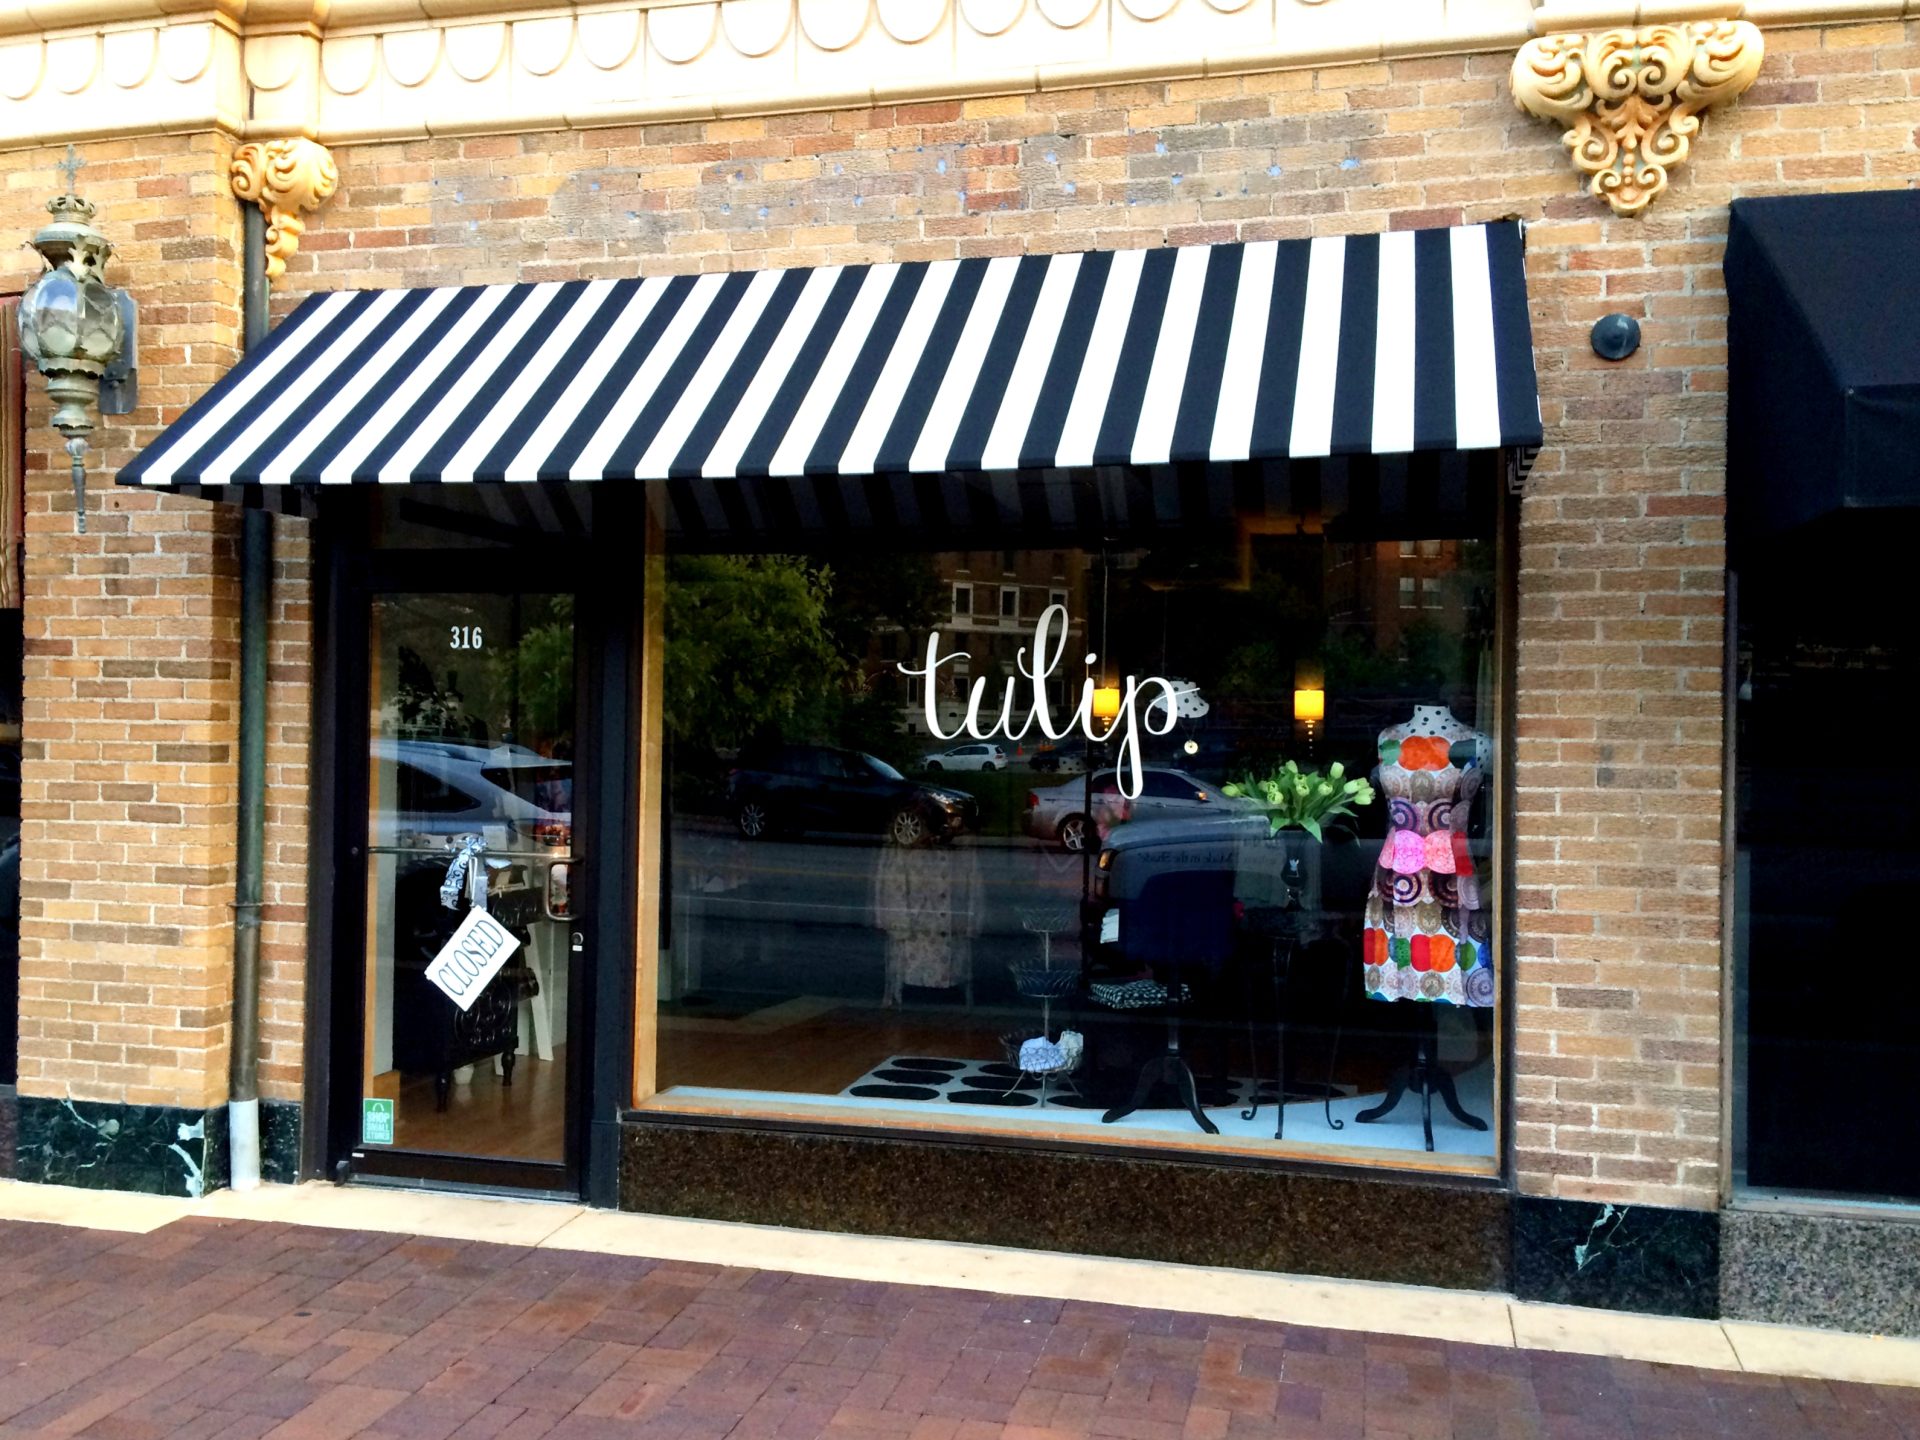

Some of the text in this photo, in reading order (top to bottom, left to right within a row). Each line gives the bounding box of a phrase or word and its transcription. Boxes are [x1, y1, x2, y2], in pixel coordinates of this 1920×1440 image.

[450, 625, 483, 649] 316
[897, 604, 1200, 799] tulip
[438, 919, 504, 996] CLOSED
